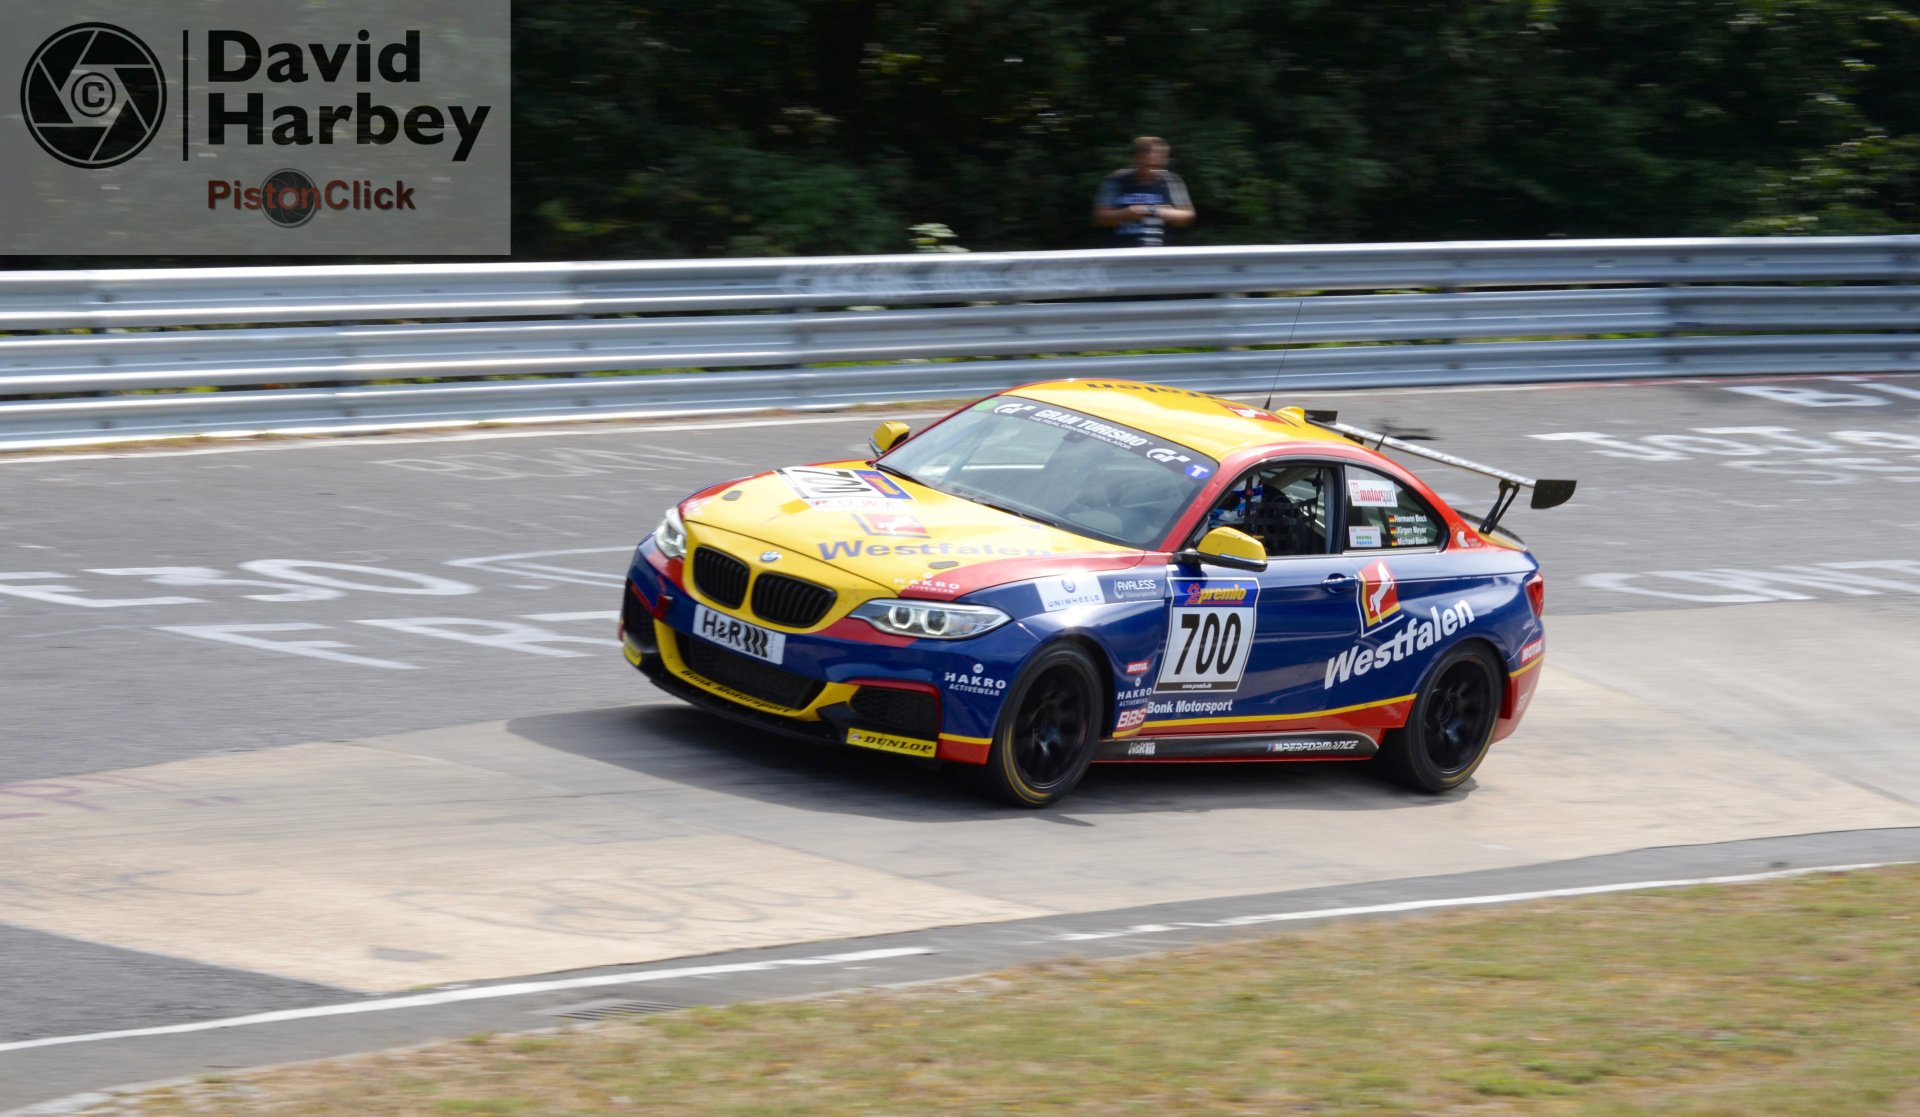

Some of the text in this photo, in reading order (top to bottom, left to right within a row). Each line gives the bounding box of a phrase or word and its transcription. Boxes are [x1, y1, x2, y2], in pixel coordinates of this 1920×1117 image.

[1034, 409, 1149, 447] GRAN TURISMO
[817, 539, 1051, 561] Westfalen
[893, 577, 961, 590] HAKRO
[1047, 594, 1101, 608] UNIWHEELS
[1200, 583, 1247, 604] premio
[1173, 612, 1242, 675] 700
[1324, 599, 1475, 690] Westfalen
[944, 671, 1007, 689] HAKRO
[681, 669, 792, 713] Bonk Motorsport
[949, 683, 1001, 697] ACTIVEWEAR
[1117, 687, 1153, 700] HAKRO
[1147, 699, 1233, 715] Bonk Motorsport
[1117, 708, 1148, 728] BBS
[863, 735, 933, 753] DUNLOP
